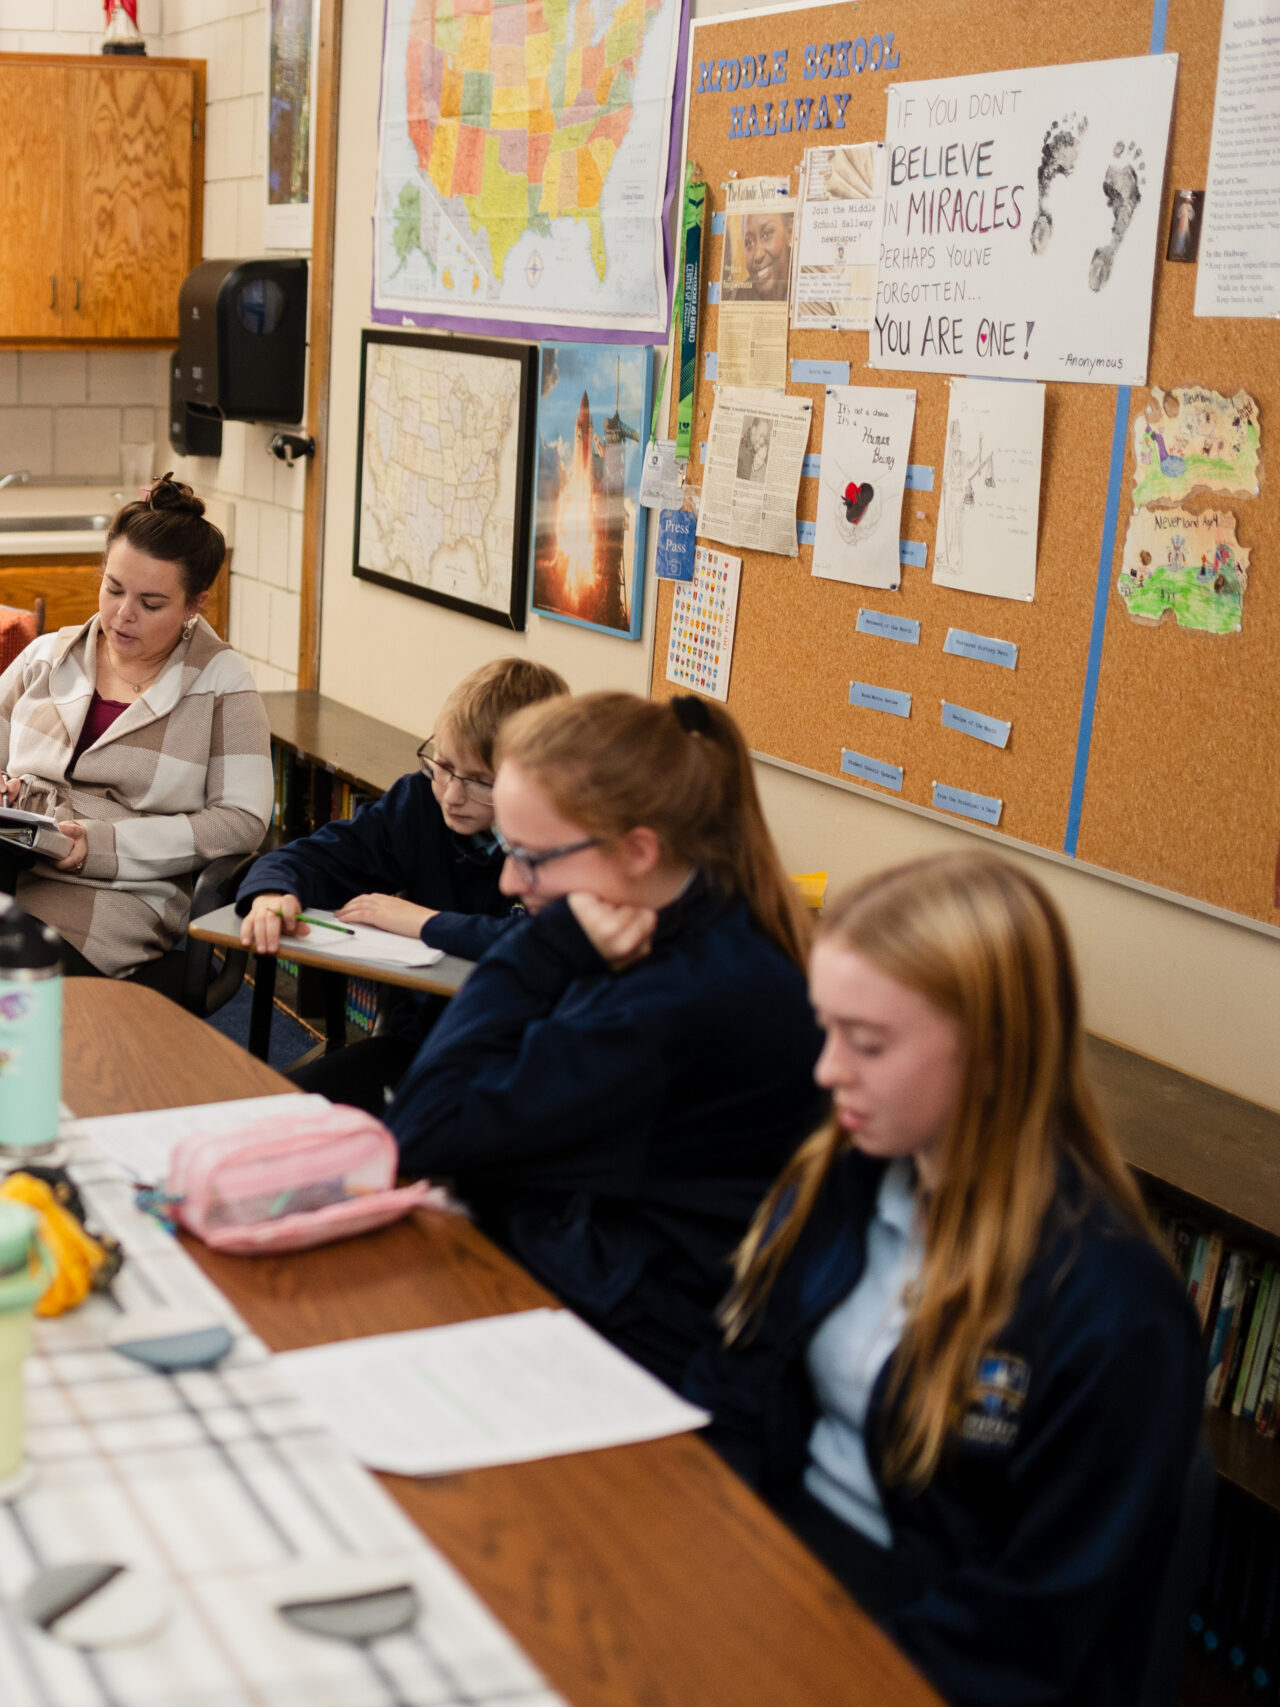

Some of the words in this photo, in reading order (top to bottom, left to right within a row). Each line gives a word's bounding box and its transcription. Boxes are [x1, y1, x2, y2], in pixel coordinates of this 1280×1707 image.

[696, 49, 788, 93] MIDDLE
[803, 32, 900, 80] SCHOOL
[728, 93, 851, 139] HALLWAY
[897, 99, 915, 128] IF
[926, 94, 957, 128] YOU
[969, 90, 1022, 119] DON'T
[891, 140, 995, 185] BELIEVE
[812, 206, 829, 216] Join
[833, 204, 845, 213] the
[848, 204, 876, 213] Middle
[884, 200, 898, 227] IN
[907, 185, 1024, 236] MIRACLES
[813, 220, 838, 230] School
[842, 219, 873, 230] Hallway
[879, 243, 936, 269] PERHAPS
[946, 244, 992, 269] YOU'VE
[875, 313, 911, 357] YOU
[921, 315, 963, 357] ARE
[837, 402, 851, 415] It's
[862, 426, 891, 446] Human
[872, 447, 895, 470] Being
[665, 520, 690, 534] Press
[1154, 515, 1199, 531] Neverland
[666, 538, 687, 554] Pass
